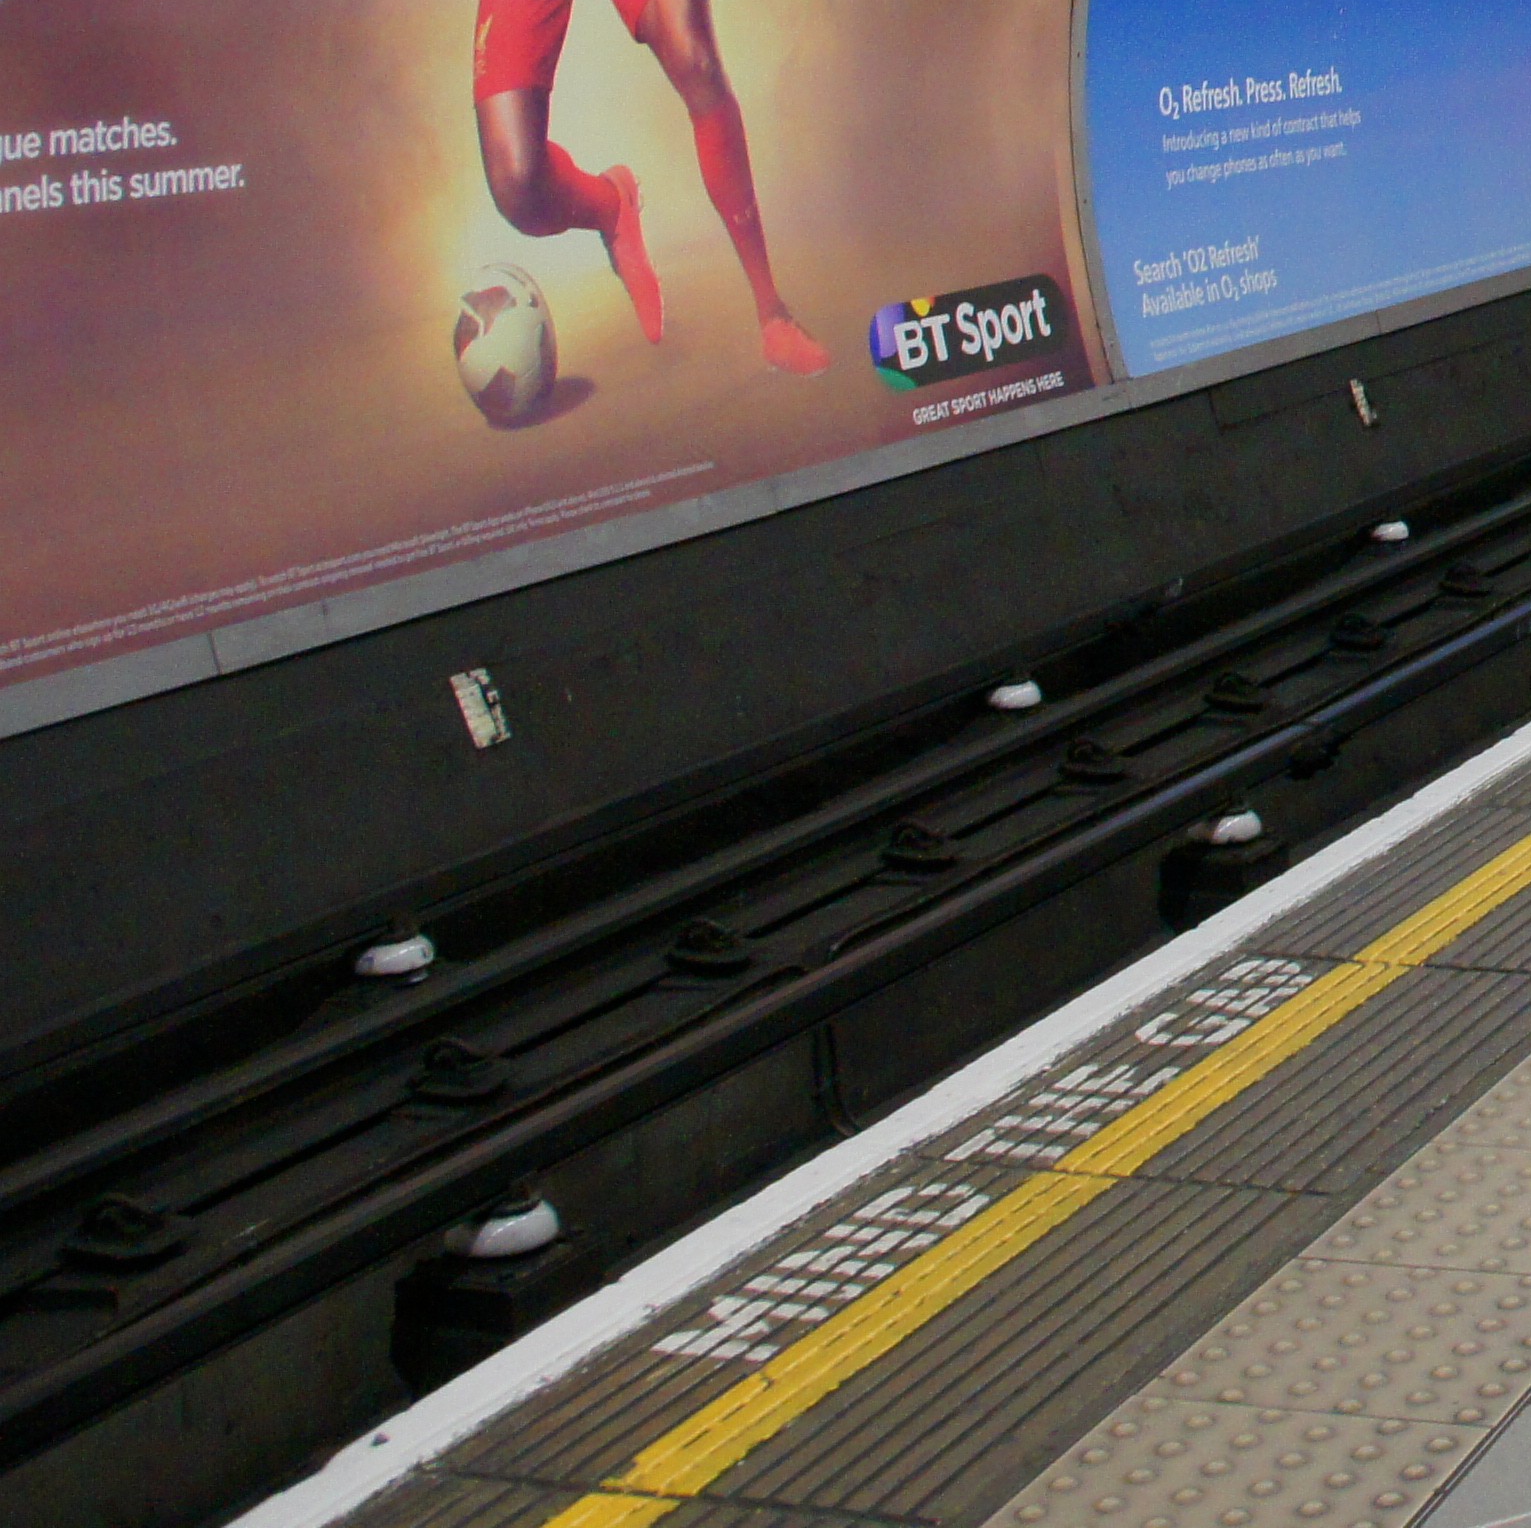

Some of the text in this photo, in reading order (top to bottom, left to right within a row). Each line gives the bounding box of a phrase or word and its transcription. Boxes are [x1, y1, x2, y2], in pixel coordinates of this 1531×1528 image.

[1182, 77, 1243, 113] Refresh.
[1246, 77, 1286, 104] Press.
[1289, 66, 1343, 99] Refresh.
[49, 116, 178, 157] matches.
[1162, 107, 1361, 153] Introducing a new kind of contract that helps
[70, 168, 123, 205] this
[129, 163, 245, 199] summer.
[1165, 169, 1185, 190] you
[1186, 163, 1223, 183] change
[1223, 157, 1256, 181] phones
[1258, 156, 1268, 171] as
[1269, 149, 1293, 168] often
[1295, 150, 1305, 164] as
[1306, 148, 1322, 167] you
[1134, 251, 1182, 285] Search
[1142, 282, 1205, 318] Available
[1205, 277, 1220, 303] in
[1240, 268, 1278, 295] shops
[893, 288, 1051, 370] BT Sport
[912, 371, 1065, 426] GREAT SPORT HAPPENS HERE
[650, 958, 1314, 1361] MIND THE GAP
